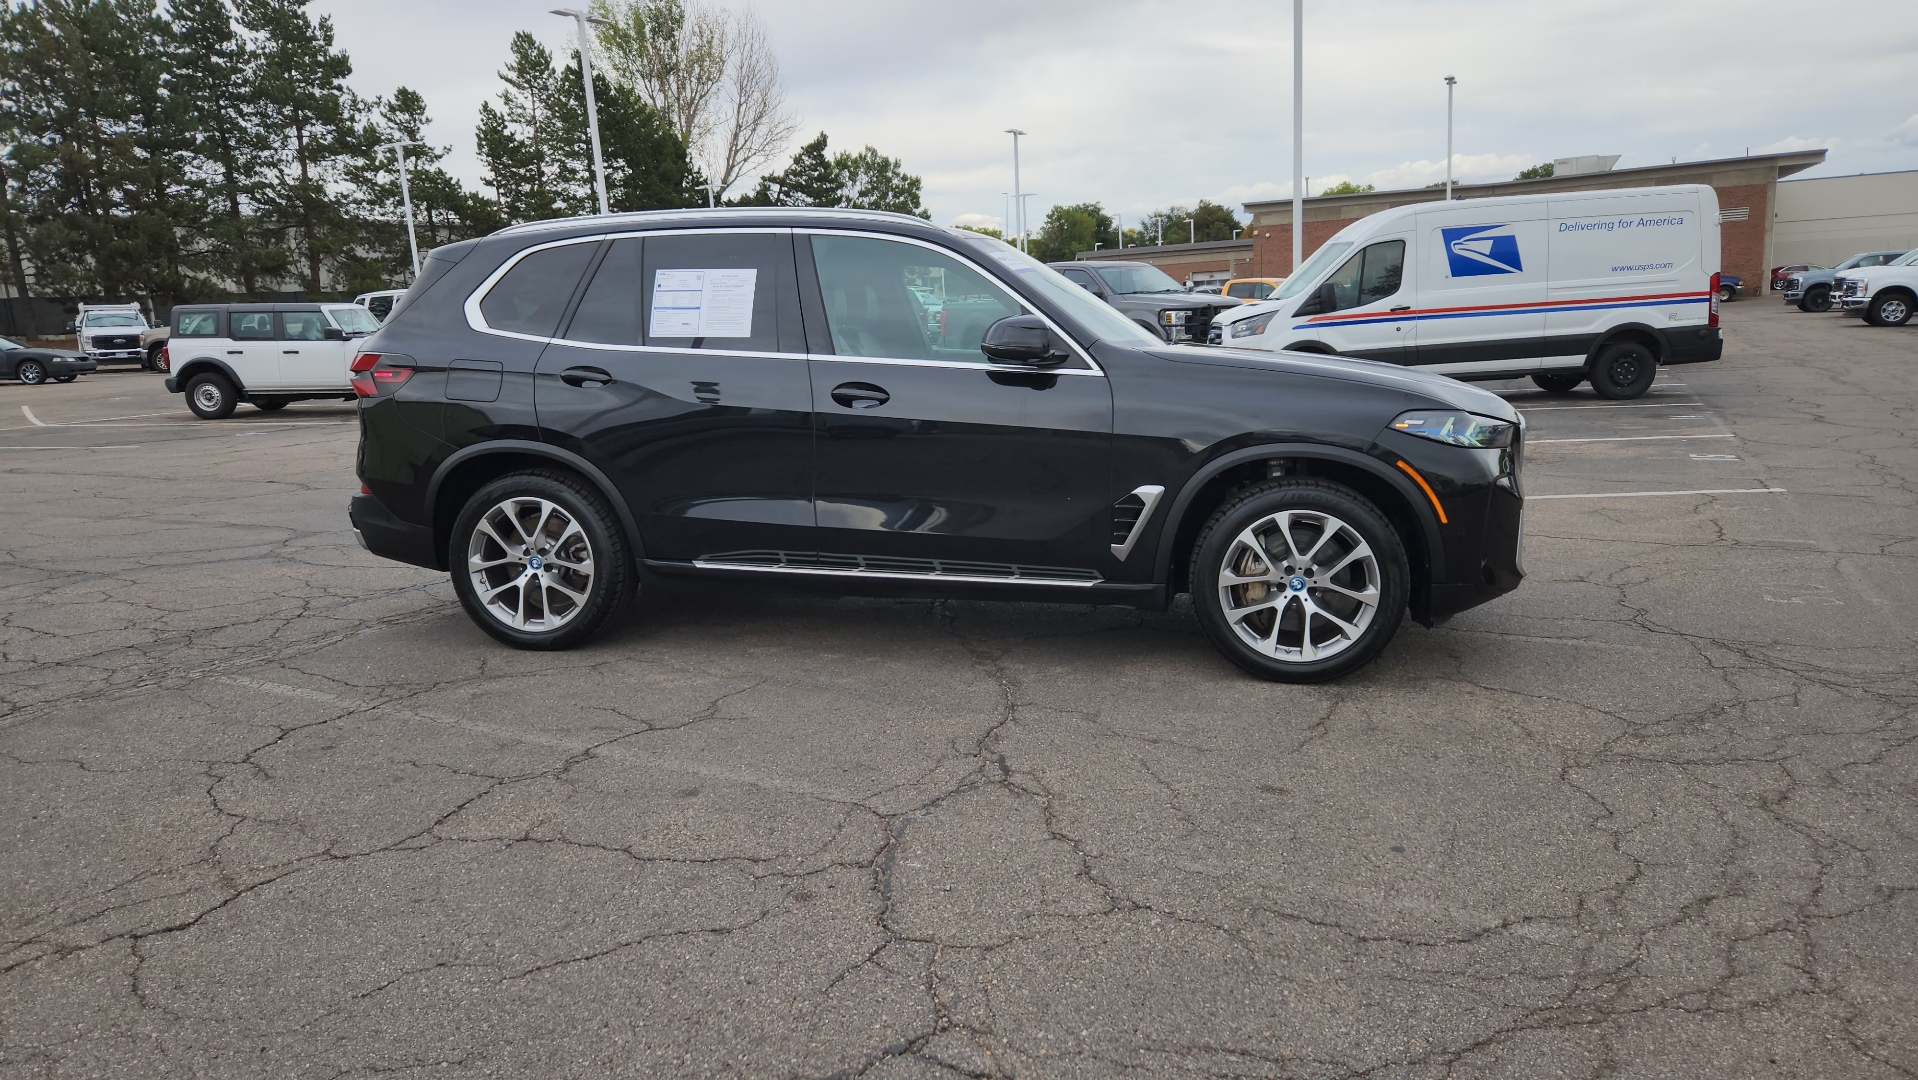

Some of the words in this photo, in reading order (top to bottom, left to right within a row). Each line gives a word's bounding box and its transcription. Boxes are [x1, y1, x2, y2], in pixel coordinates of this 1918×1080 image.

[1559, 221, 1614, 232] Delivering
[1617, 218, 1634, 229] for
[1636, 216, 1684, 228] America
[1611, 262, 1673, 272] www.usps.com
